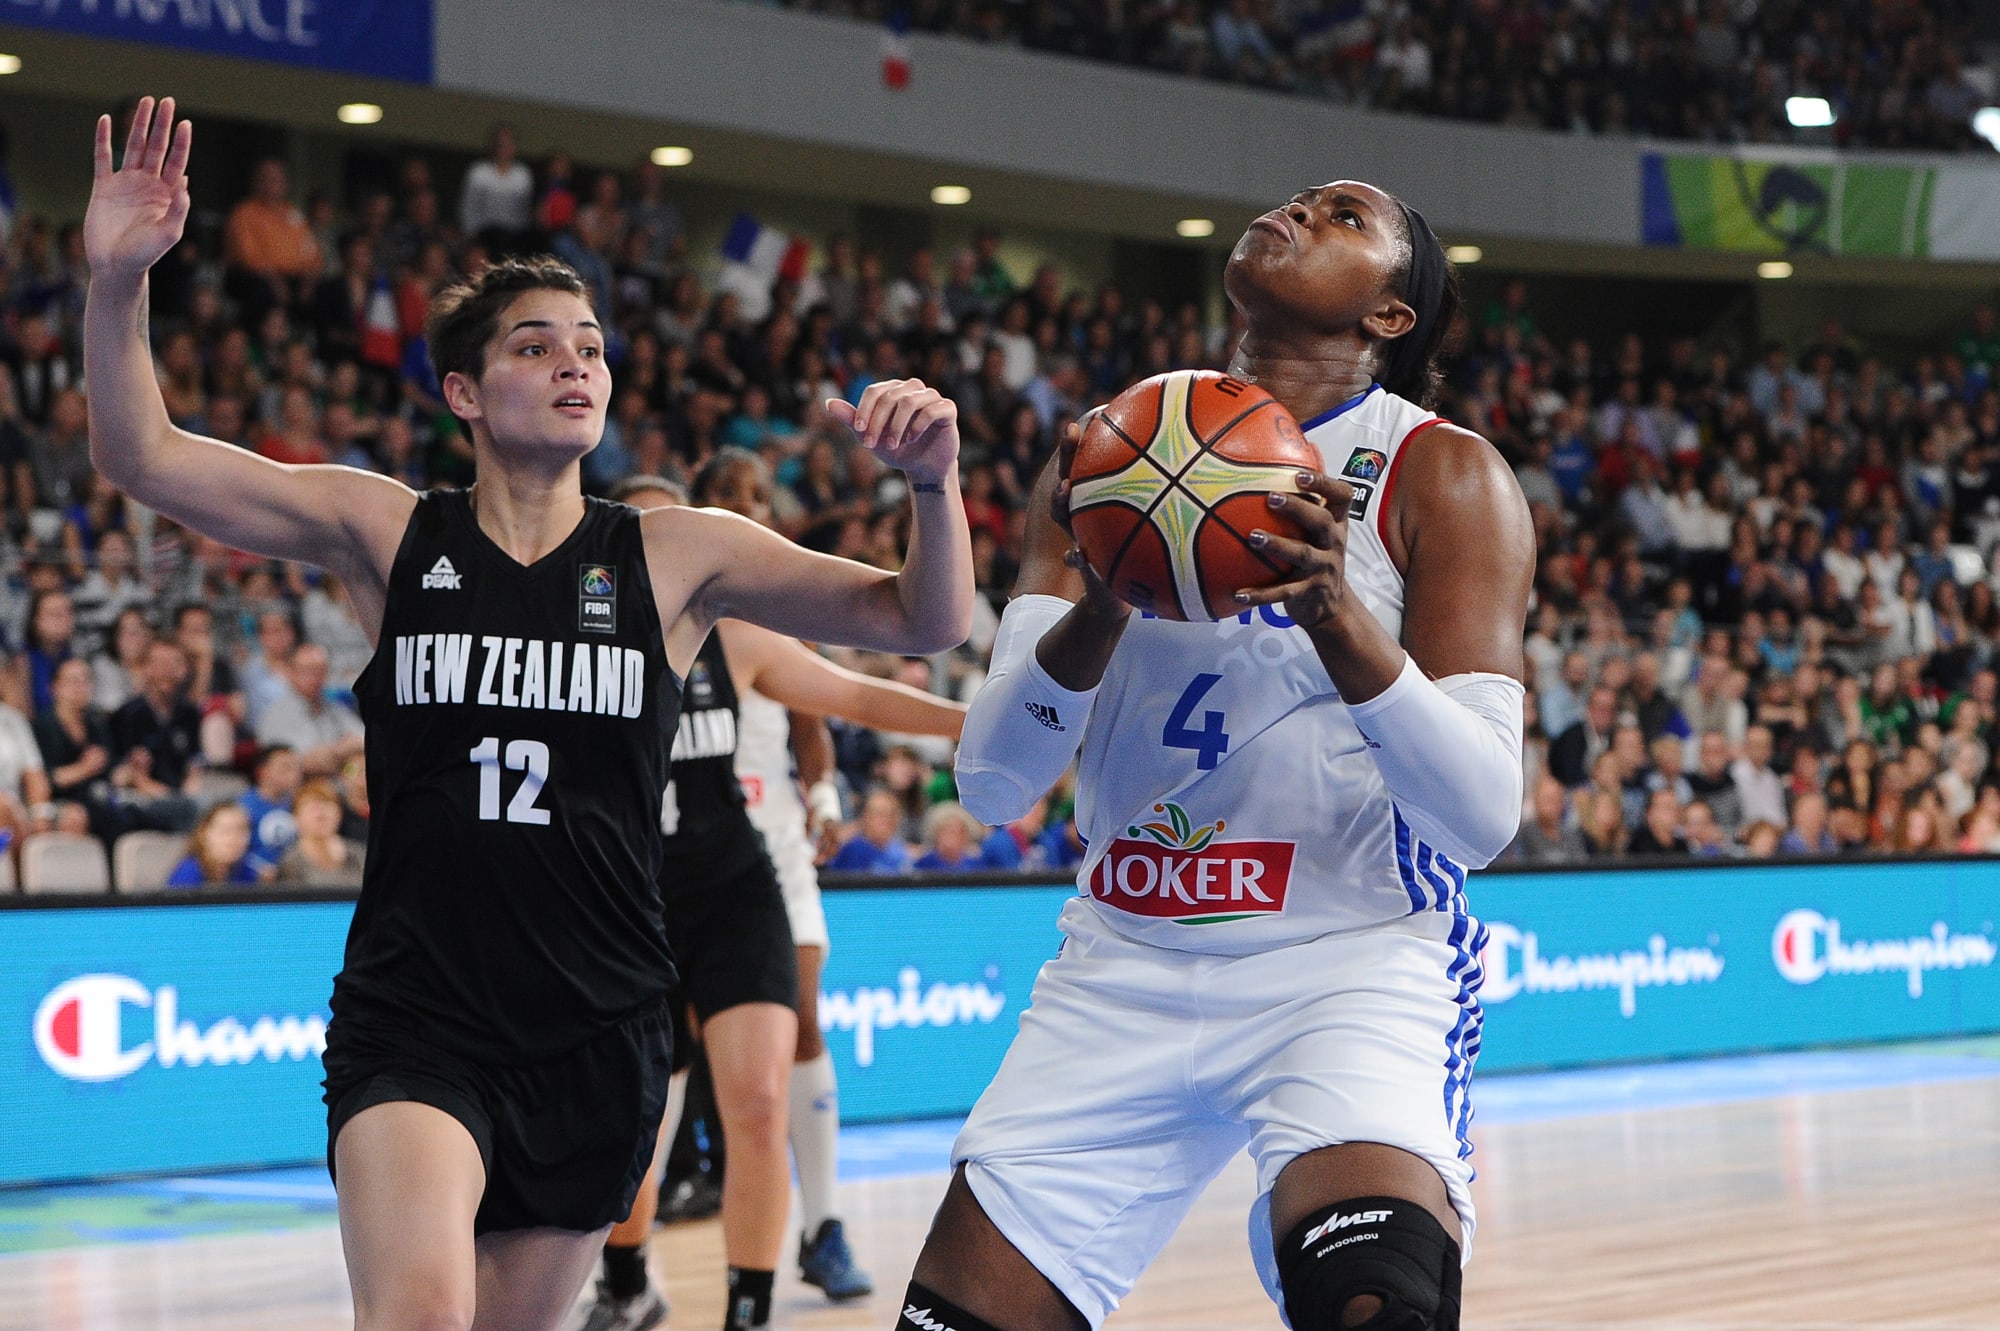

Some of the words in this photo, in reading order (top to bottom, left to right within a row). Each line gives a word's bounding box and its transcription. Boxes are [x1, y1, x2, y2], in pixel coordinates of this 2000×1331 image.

[422, 574, 463, 589] PEAK
[585, 602, 610, 615] FIBA
[396, 634, 472, 705] NEW
[478, 636, 644, 718] ZEALAND
[670, 708, 736, 761] LAND
[1025, 702, 1066, 732] adidas
[1162, 673, 1229, 771] 4
[469, 737, 551, 826] 12
[1101, 852, 1275, 906] JOKER
[1479, 922, 1725, 1018] Champion
[1772, 908, 1998, 999] Champion
[32, 973, 328, 1082] Cham
[818, 965, 1006, 1067] mpion
[1301, 1210, 1394, 1250] ZAMST
[902, 1304, 957, 1331] ZAM
